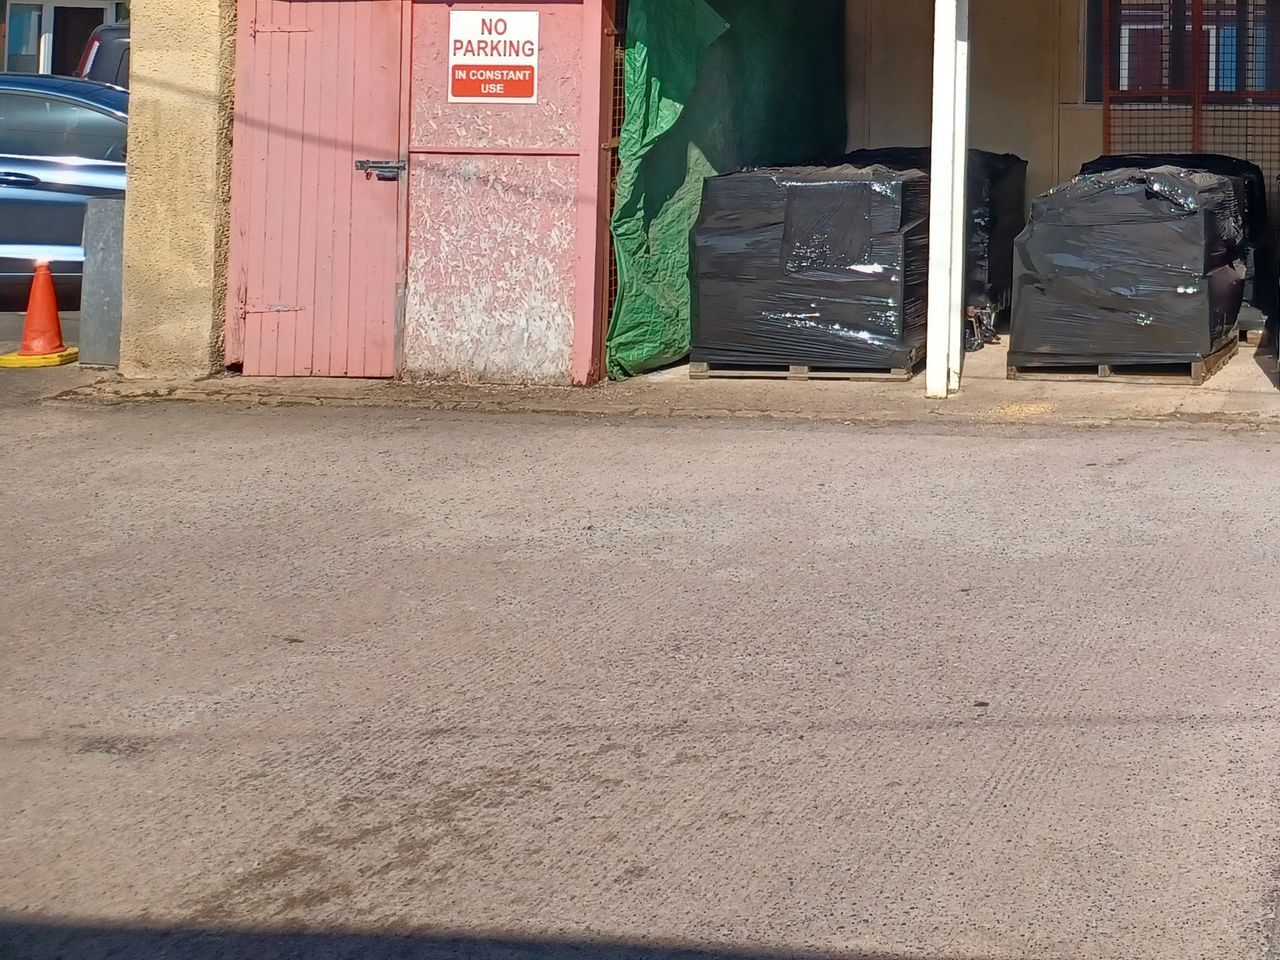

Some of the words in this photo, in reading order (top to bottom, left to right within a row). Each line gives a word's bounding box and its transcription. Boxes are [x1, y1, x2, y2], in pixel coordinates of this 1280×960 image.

[481, 18, 507, 35] NO
[453, 39, 534, 57] PARKING
[455, 69, 466, 80] IN
[469, 69, 531, 81] CONSTANT
[480, 83, 504, 94] USE
